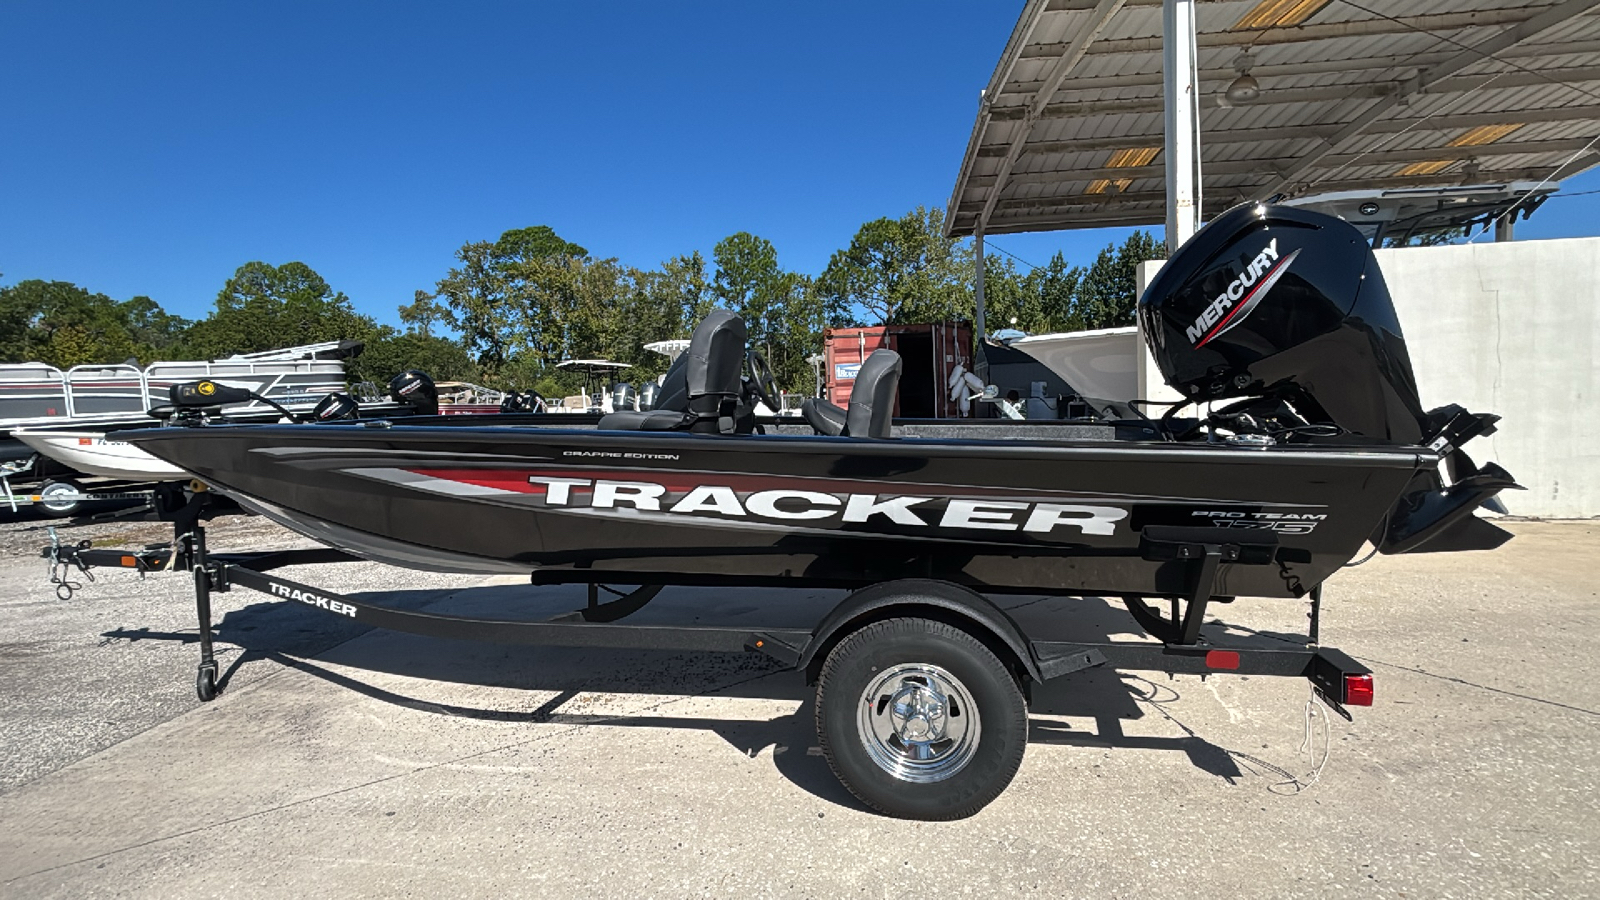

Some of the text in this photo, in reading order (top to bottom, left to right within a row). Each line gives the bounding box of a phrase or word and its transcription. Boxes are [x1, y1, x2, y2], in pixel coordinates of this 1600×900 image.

[1186, 237, 1279, 344] MERCURY
[623, 452, 680, 460] EDITION
[528, 475, 1129, 536] TRACKER
[1191, 510, 1328, 520] PRO TEAM
[268, 581, 358, 618] TRACKER
